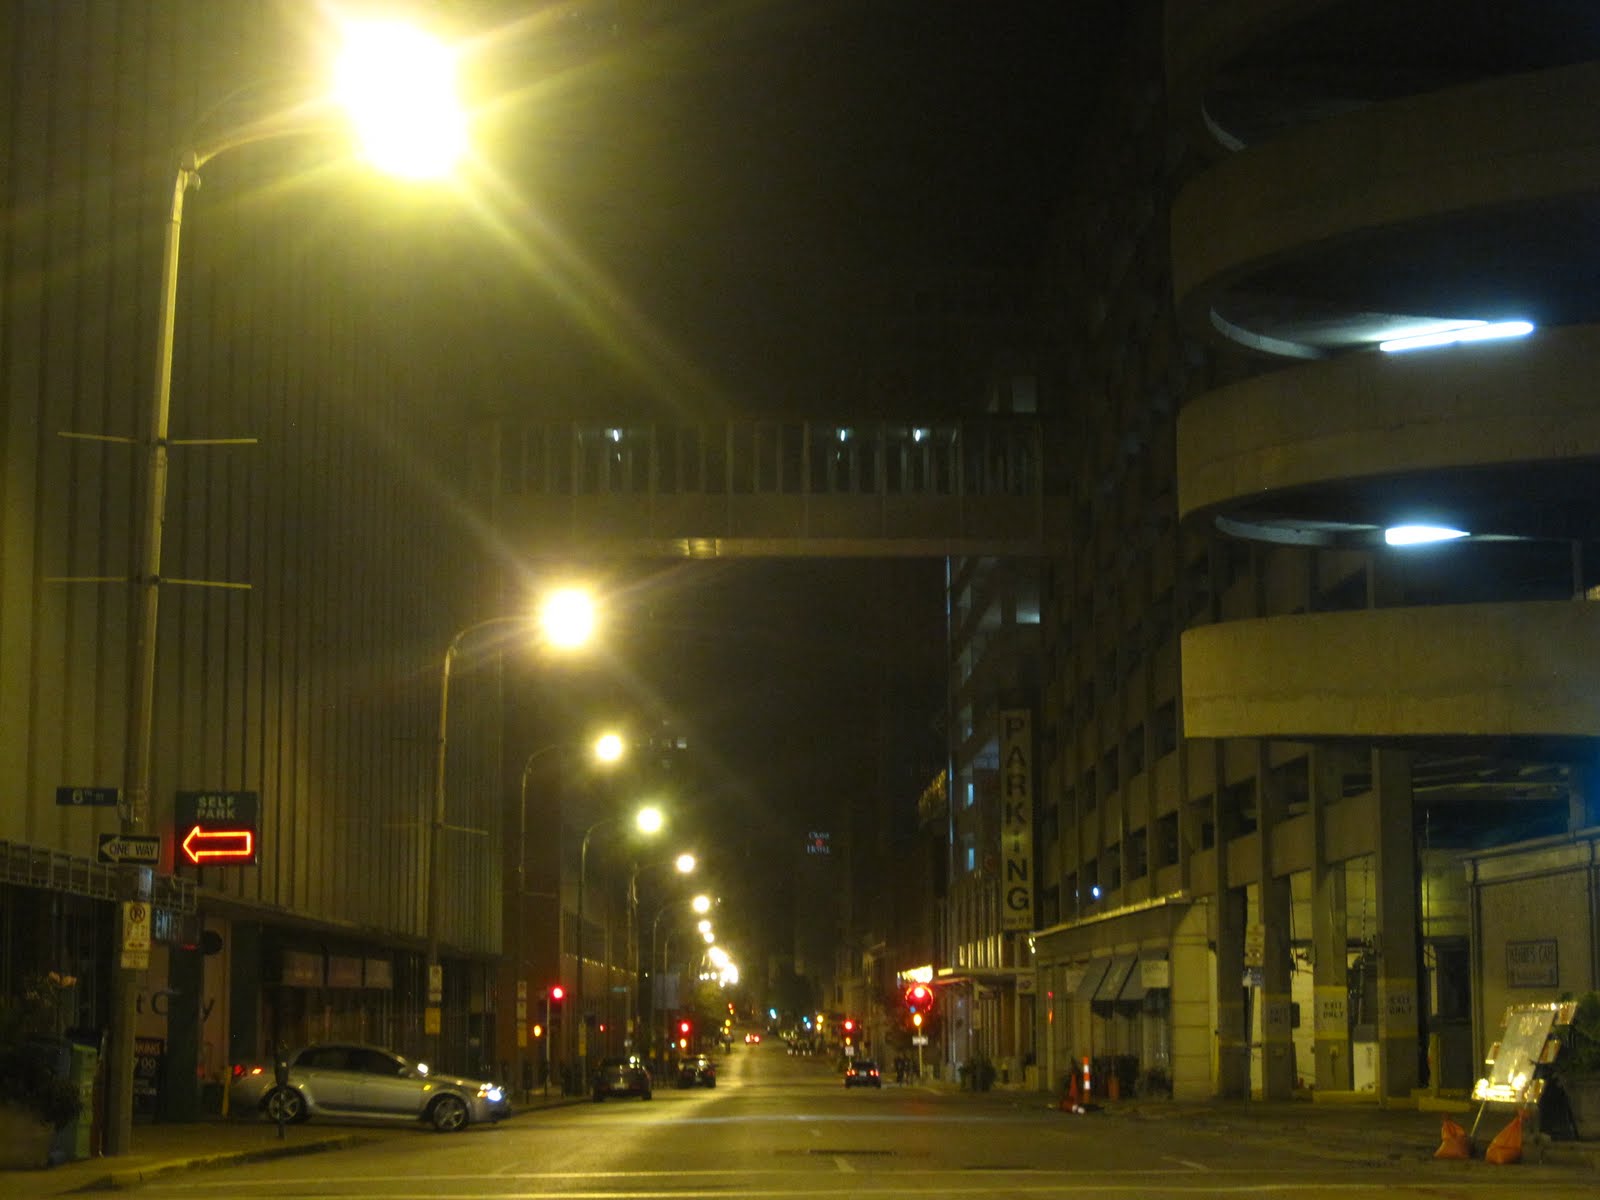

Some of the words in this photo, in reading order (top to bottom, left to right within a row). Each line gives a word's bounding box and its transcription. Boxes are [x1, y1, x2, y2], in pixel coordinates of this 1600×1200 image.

[198, 795, 235, 808] SELF
[197, 808, 235, 820] PARK
[1006, 718, 1030, 911] PARKING
[109, 843, 128, 857] ONE
[135, 844, 154, 857] WAY
[1323, 1001, 1342, 1009] EXIT
[1323, 1011, 1344, 1019] ONLY
